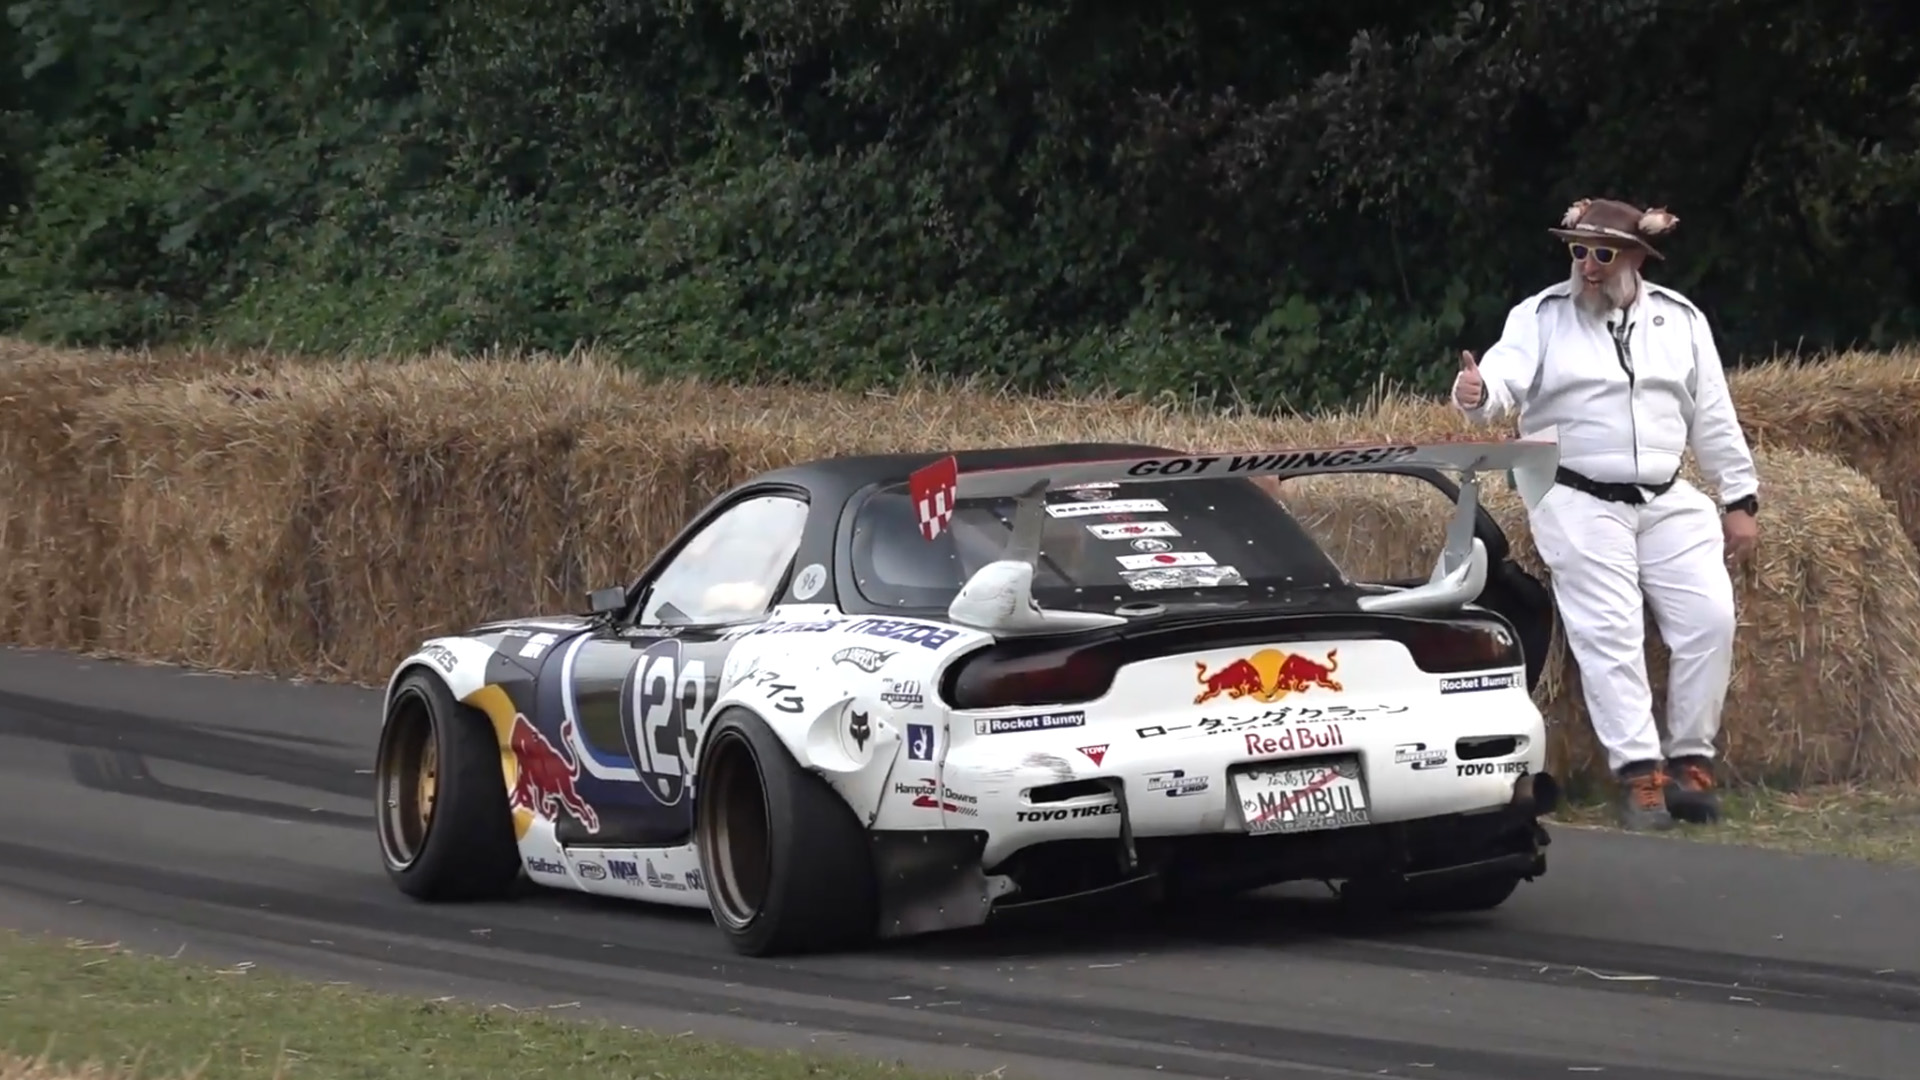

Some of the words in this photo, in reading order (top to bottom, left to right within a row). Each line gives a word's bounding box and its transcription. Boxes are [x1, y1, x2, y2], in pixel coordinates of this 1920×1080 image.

[1127, 456, 1219, 476] GOT
[1441, 677, 1479, 691] Rocket
[1481, 675, 1511, 688] Bunny
[633, 655, 706, 776] 123
[992, 717, 1039, 731] Rocket
[1042, 713, 1085, 726] Bunny
[1245, 729, 1295, 755] Red
[1296, 724, 1343, 749] Bull
[1082, 746, 1106, 755] TOW
[1456, 762, 1494, 777] TOYO
[1496, 761, 1529, 774] TIRES
[945, 788, 977, 804] Downs
[1016, 810, 1067, 822] TOYO
[1071, 803, 1122, 818] TIRES
[527, 856, 567, 875] Haltech
